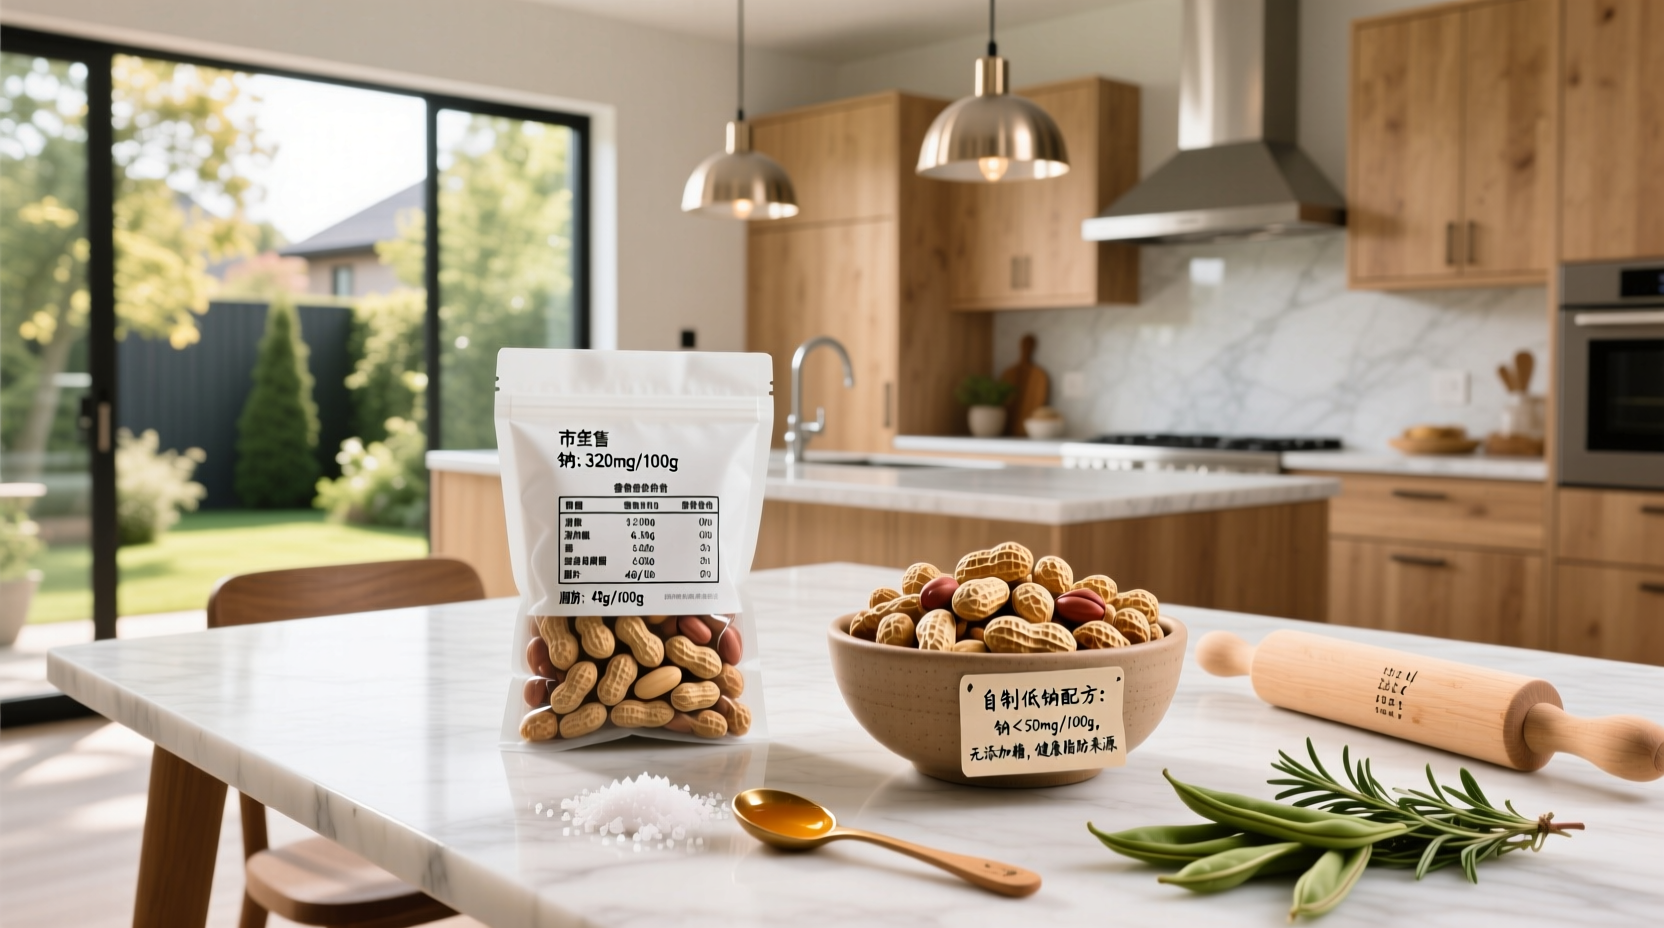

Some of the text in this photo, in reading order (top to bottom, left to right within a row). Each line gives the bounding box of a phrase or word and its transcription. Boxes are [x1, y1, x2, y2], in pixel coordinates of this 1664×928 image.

[585, 452, 679, 473] 320mg/100g
[984, 685, 1105, 712] 自制低钠配方:
